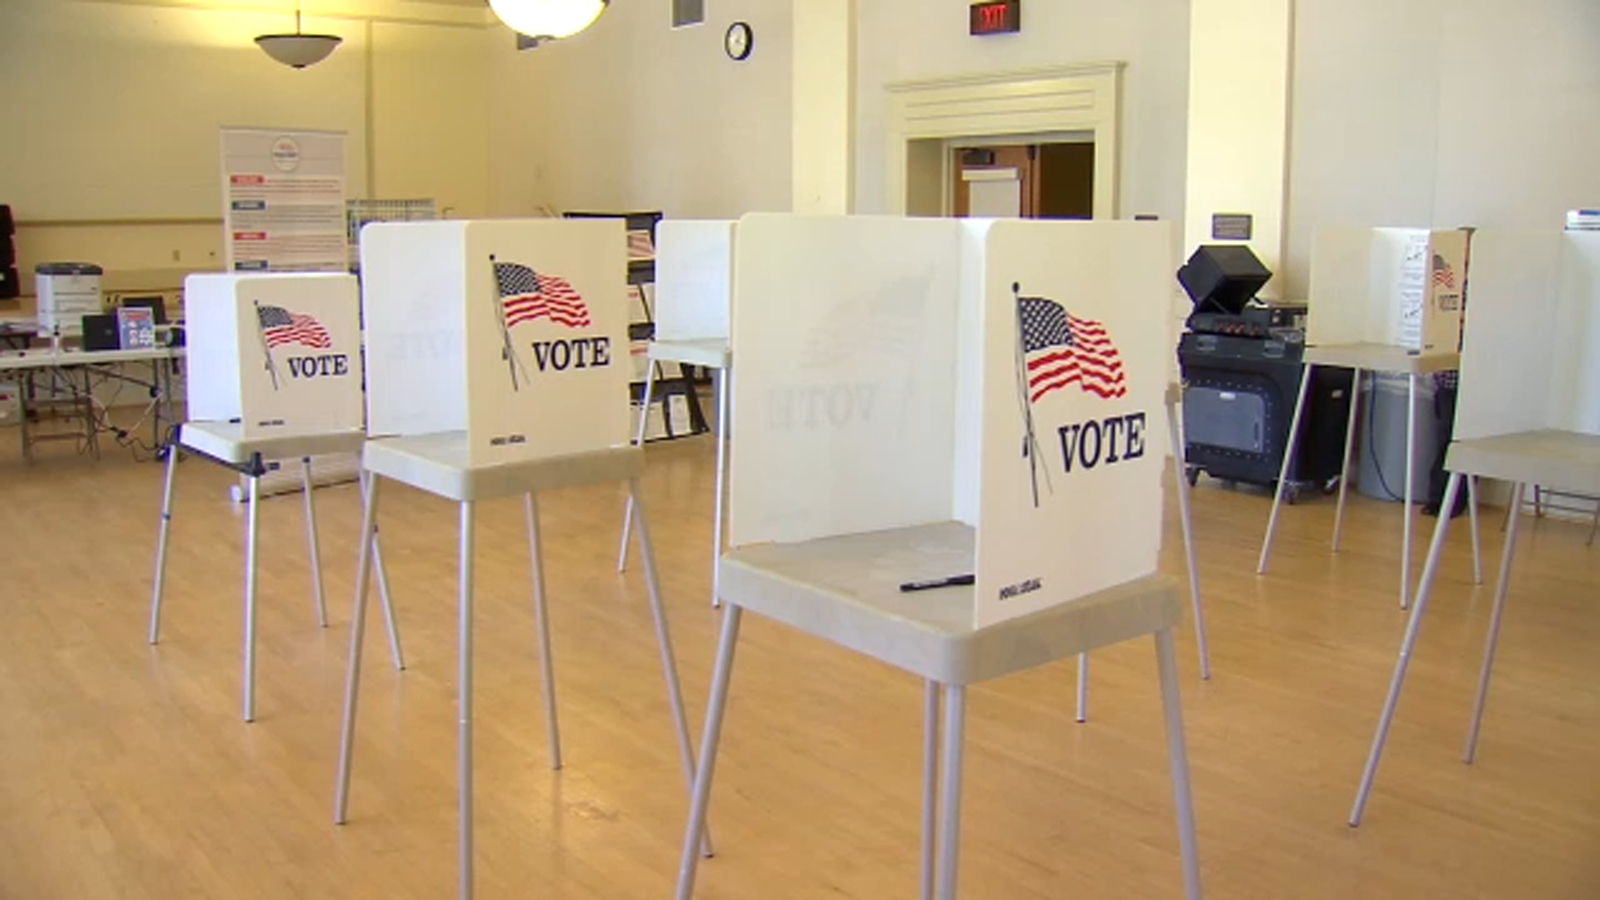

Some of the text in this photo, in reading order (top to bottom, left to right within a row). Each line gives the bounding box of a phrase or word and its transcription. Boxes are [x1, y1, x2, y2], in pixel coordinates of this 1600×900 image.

[287, 354, 348, 378] VOTE
[532, 337, 610, 371] VOTE
[1058, 412, 1145, 473] VOTE
